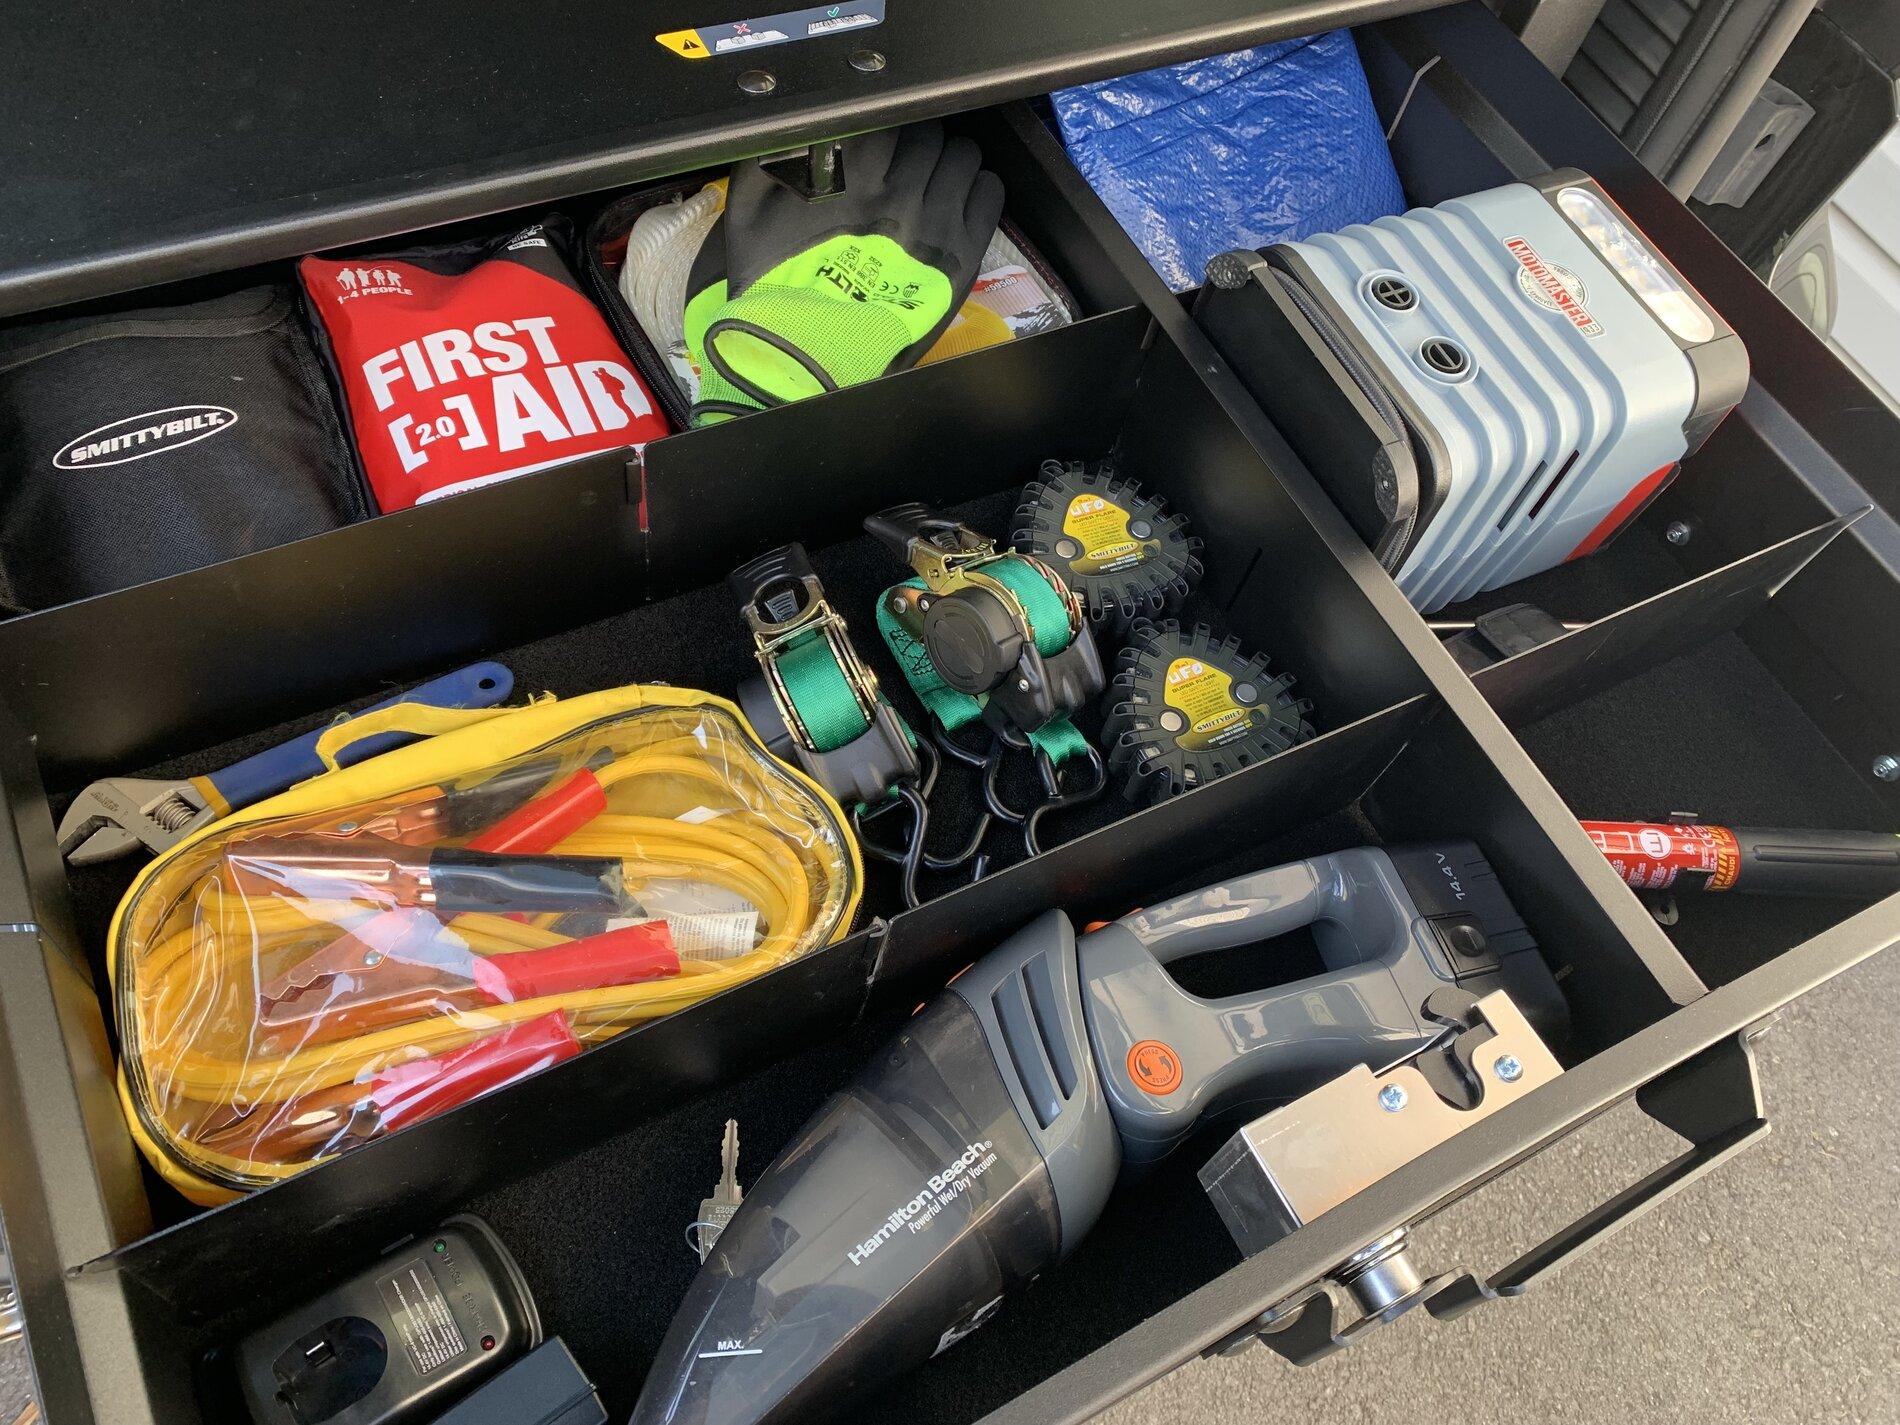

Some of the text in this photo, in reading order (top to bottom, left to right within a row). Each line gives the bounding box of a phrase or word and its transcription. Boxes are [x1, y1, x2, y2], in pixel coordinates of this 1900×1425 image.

[337, 286, 413, 304] 1-4 PEOPLE
[1510, 243, 1591, 327] MOTOMASTER
[362, 316, 562, 412] FIRST
[491, 360, 653, 453] AID
[1091, 544, 1134, 558] SMITTYBILT
[1168, 662, 1203, 684] UFO
[1170, 672, 1217, 693] SUPER FLARE
[1197, 710, 1241, 731] SMITTYBILT
[907, 1152, 998, 1234] Powerful Wet/Dry Vacuum
[847, 1189, 934, 1266] Hamilton
[717, 1339, 745, 1351] MAX.
